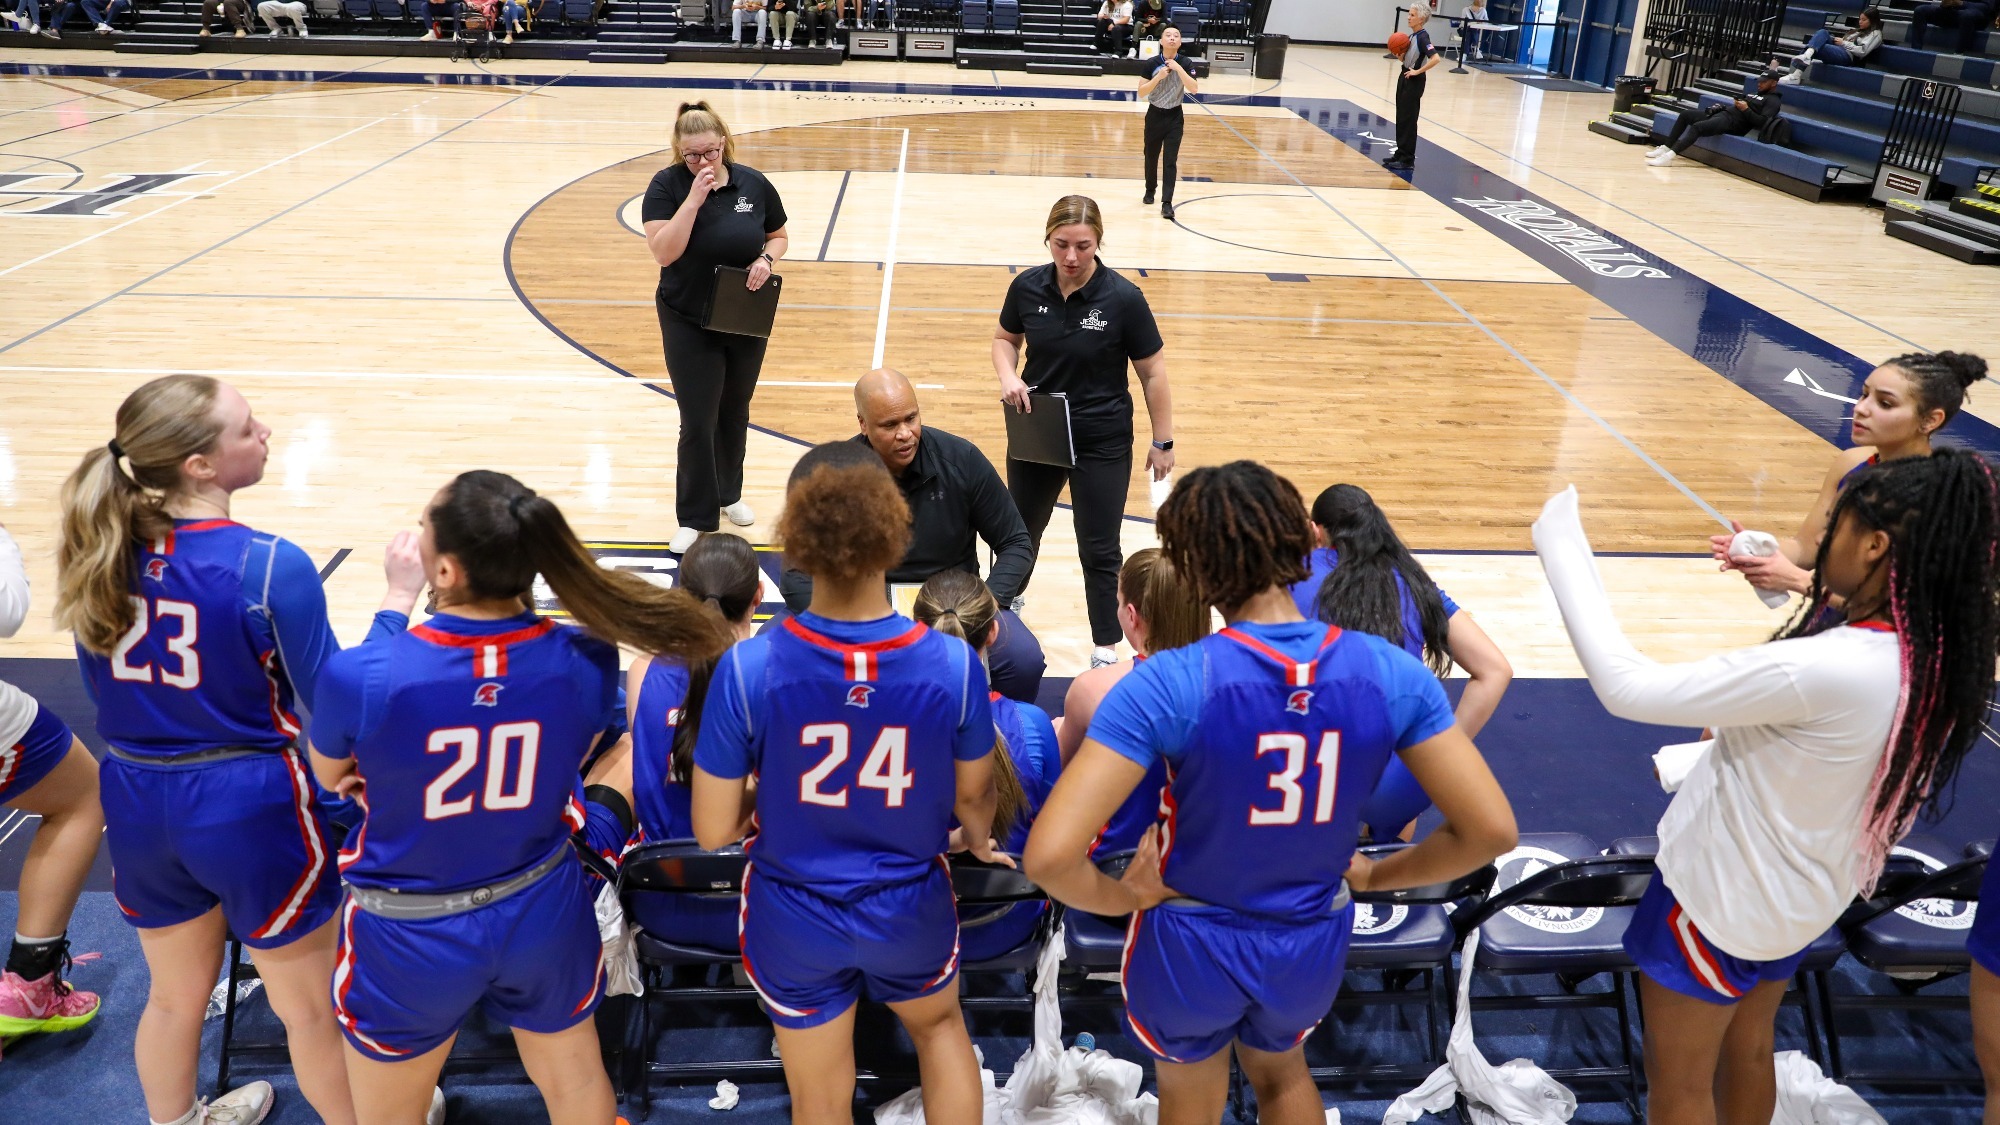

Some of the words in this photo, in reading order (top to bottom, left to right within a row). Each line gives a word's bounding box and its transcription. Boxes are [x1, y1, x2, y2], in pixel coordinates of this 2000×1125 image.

[1452, 196, 1672, 279] ROYALS
[1080, 318, 1108, 327] JESSUP
[111, 594, 202, 690] 23
[424, 719, 542, 821] 20
[798, 721, 915, 809] 24
[1247, 729, 1342, 826] 31
